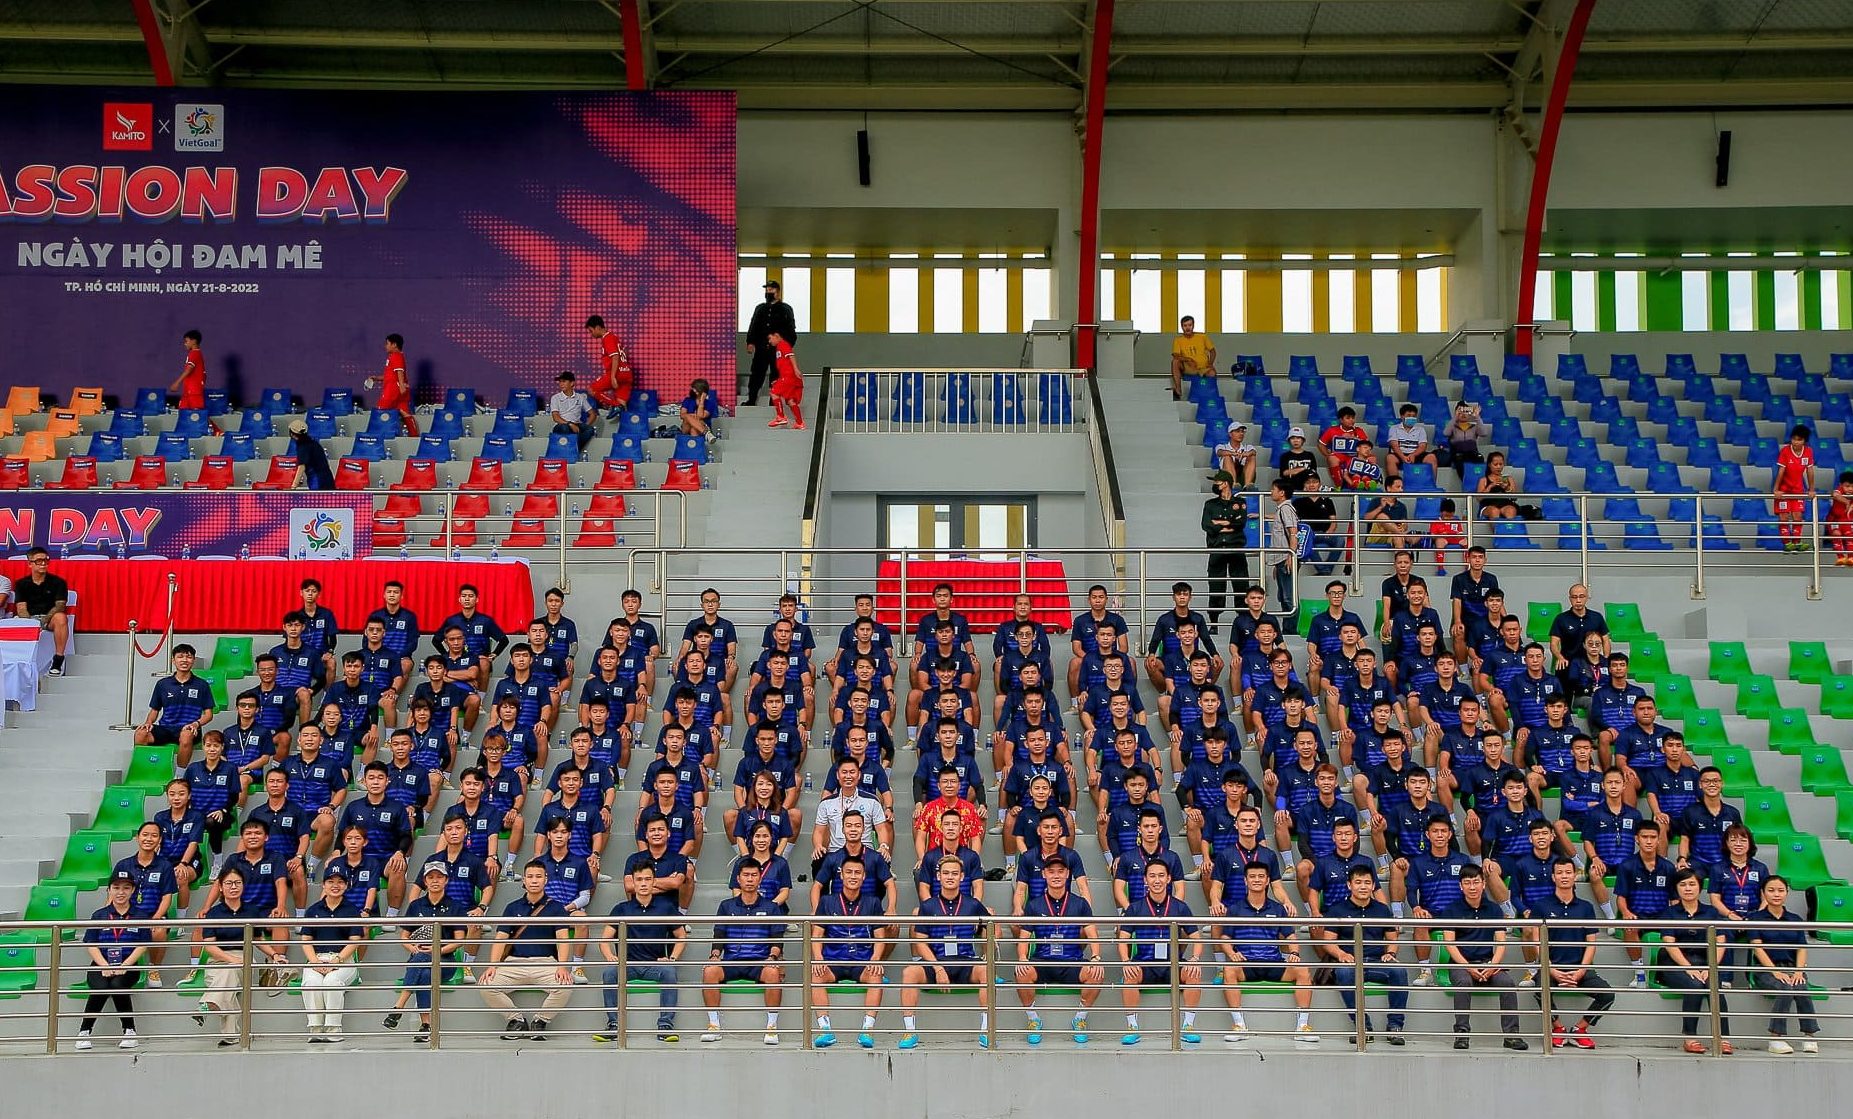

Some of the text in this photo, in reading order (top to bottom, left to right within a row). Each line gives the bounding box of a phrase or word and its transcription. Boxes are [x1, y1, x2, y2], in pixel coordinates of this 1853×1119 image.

[111, 131, 146, 141] KAMITO
[0, 164, 409, 224] SSION DAY
[17, 236, 323, 275] NGÀY HỘI ĐAM MÊ
[65, 282, 82, 292] TP.
[105, 280, 126, 292] CHÍ
[128, 282, 164, 294] MINH,
[166, 281, 200, 293] NGÀY
[202, 283, 259, 293] 21-8-2022
[1348, 439, 1355, 450] 7
[1363, 462, 1377, 476] 22
[48, 506, 163, 551] DAY
